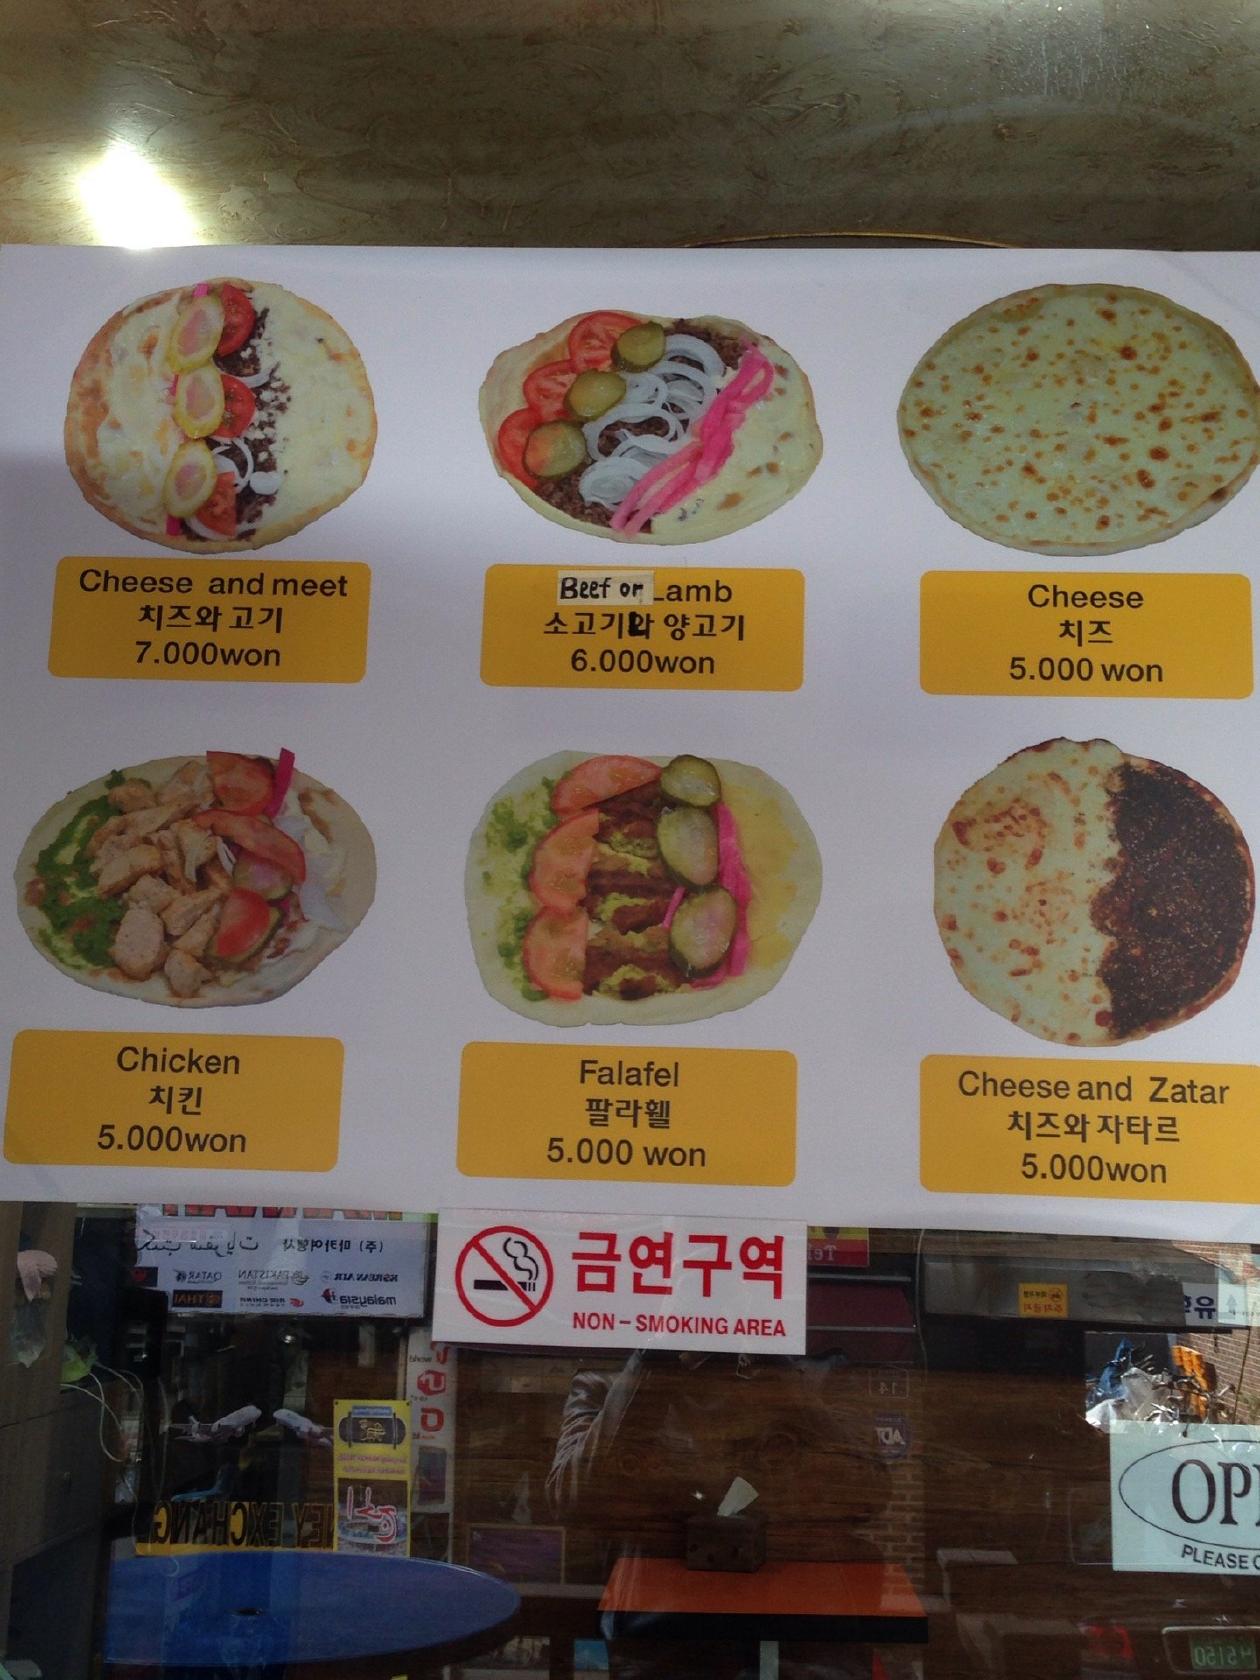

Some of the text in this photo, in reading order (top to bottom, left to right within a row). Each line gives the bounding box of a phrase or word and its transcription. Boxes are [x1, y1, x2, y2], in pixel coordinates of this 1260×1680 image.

[80, 569, 347, 596] Cheese and meet
[561, 577, 643, 600] Beef or
[653, 580, 732, 603] amb
[1028, 584, 1143, 608] Cheese
[139, 605, 282, 633] 치즈와 고기
[664, 614, 744, 640] 양고기
[1060, 620, 1112, 647] 치즈
[136, 641, 280, 666] 7.000won
[571, 649, 714, 673] 6.000won
[1010, 657, 1162, 681] 5.000 won
[117, 1046, 239, 1074] Chicken
[580, 1060, 678, 1087] Falafel
[149, 1086, 201, 1115] 치킨
[959, 1071, 1229, 1104] Cheese and Zatar
[586, 1099, 669, 1129] 팔라휄
[98, 1125, 246, 1152] 5.000won
[1008, 1111, 1179, 1145] 치즈와 자타르
[548, 1138, 705, 1166] 5.000 won
[1022, 1153, 1166, 1183] 5.000won
[572, 1232, 784, 1299] 금연구역
[734, 1319, 785, 1336] AREA
[1182, 1544, 1249, 1569] PLEASE
